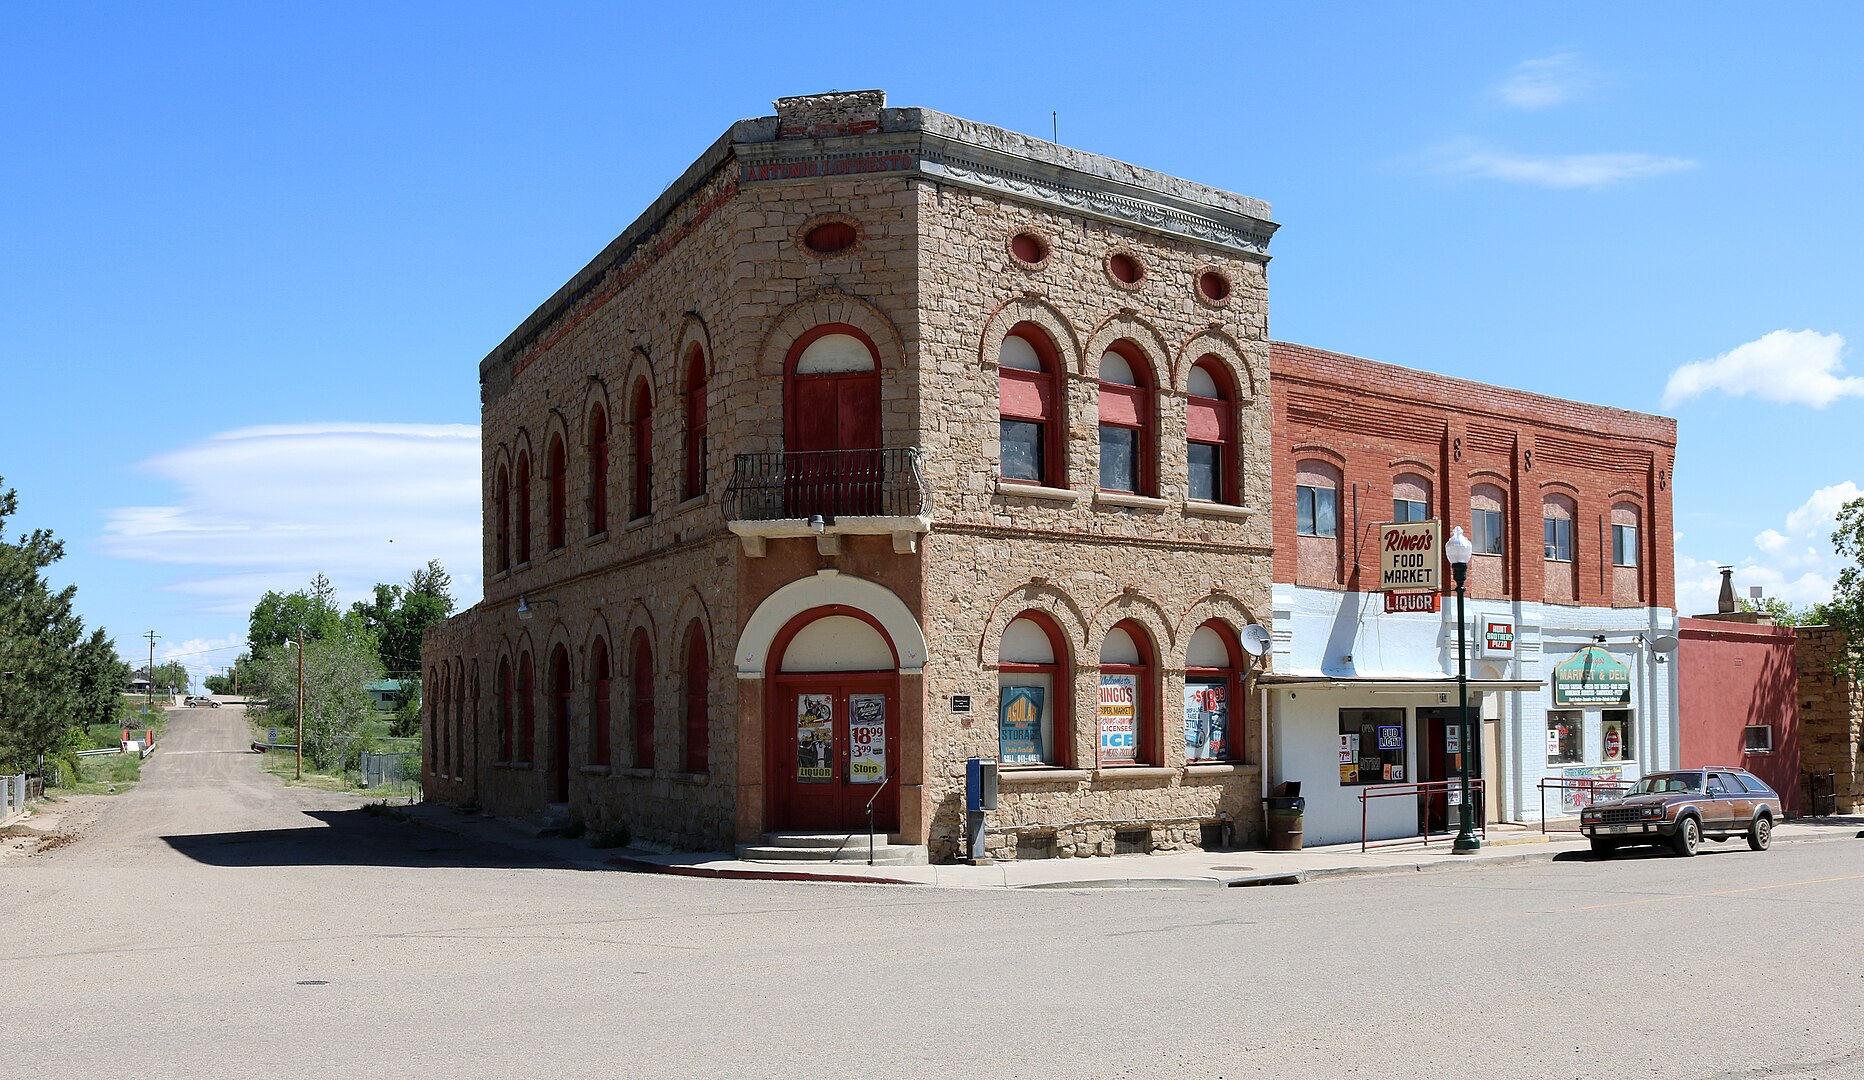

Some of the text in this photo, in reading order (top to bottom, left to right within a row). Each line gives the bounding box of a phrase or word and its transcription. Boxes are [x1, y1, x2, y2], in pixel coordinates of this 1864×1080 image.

[746, 163, 818, 181] ANTONIO
[1393, 553, 1424, 568] FOOD
[1384, 569, 1432, 583] MARKET
[1386, 595, 1433, 611] LIQUOR
[1491, 640, 1508, 648] PIZZA
[1560, 669, 1627, 681] MARKET & DELI
[1099, 686, 1133, 703] RINGO'S
[1006, 696, 1037, 722] AGUILAR
[1099, 706, 1131, 715] SUPER MARKET
[1361, 724, 1374, 733] OPEN
[1383, 728, 1398, 737] BUD
[1002, 729, 1040, 741] STORAGE
[1102, 733, 1133, 747] ICE
[1380, 736, 1401, 747] LIGHT
[1003, 754, 1016, 763] CALL
[1360, 757, 1381, 770] ATM
[800, 768, 831, 777] LIQUOR
[853, 763, 878, 774] Store
[1392, 770, 1402, 778] ICE
